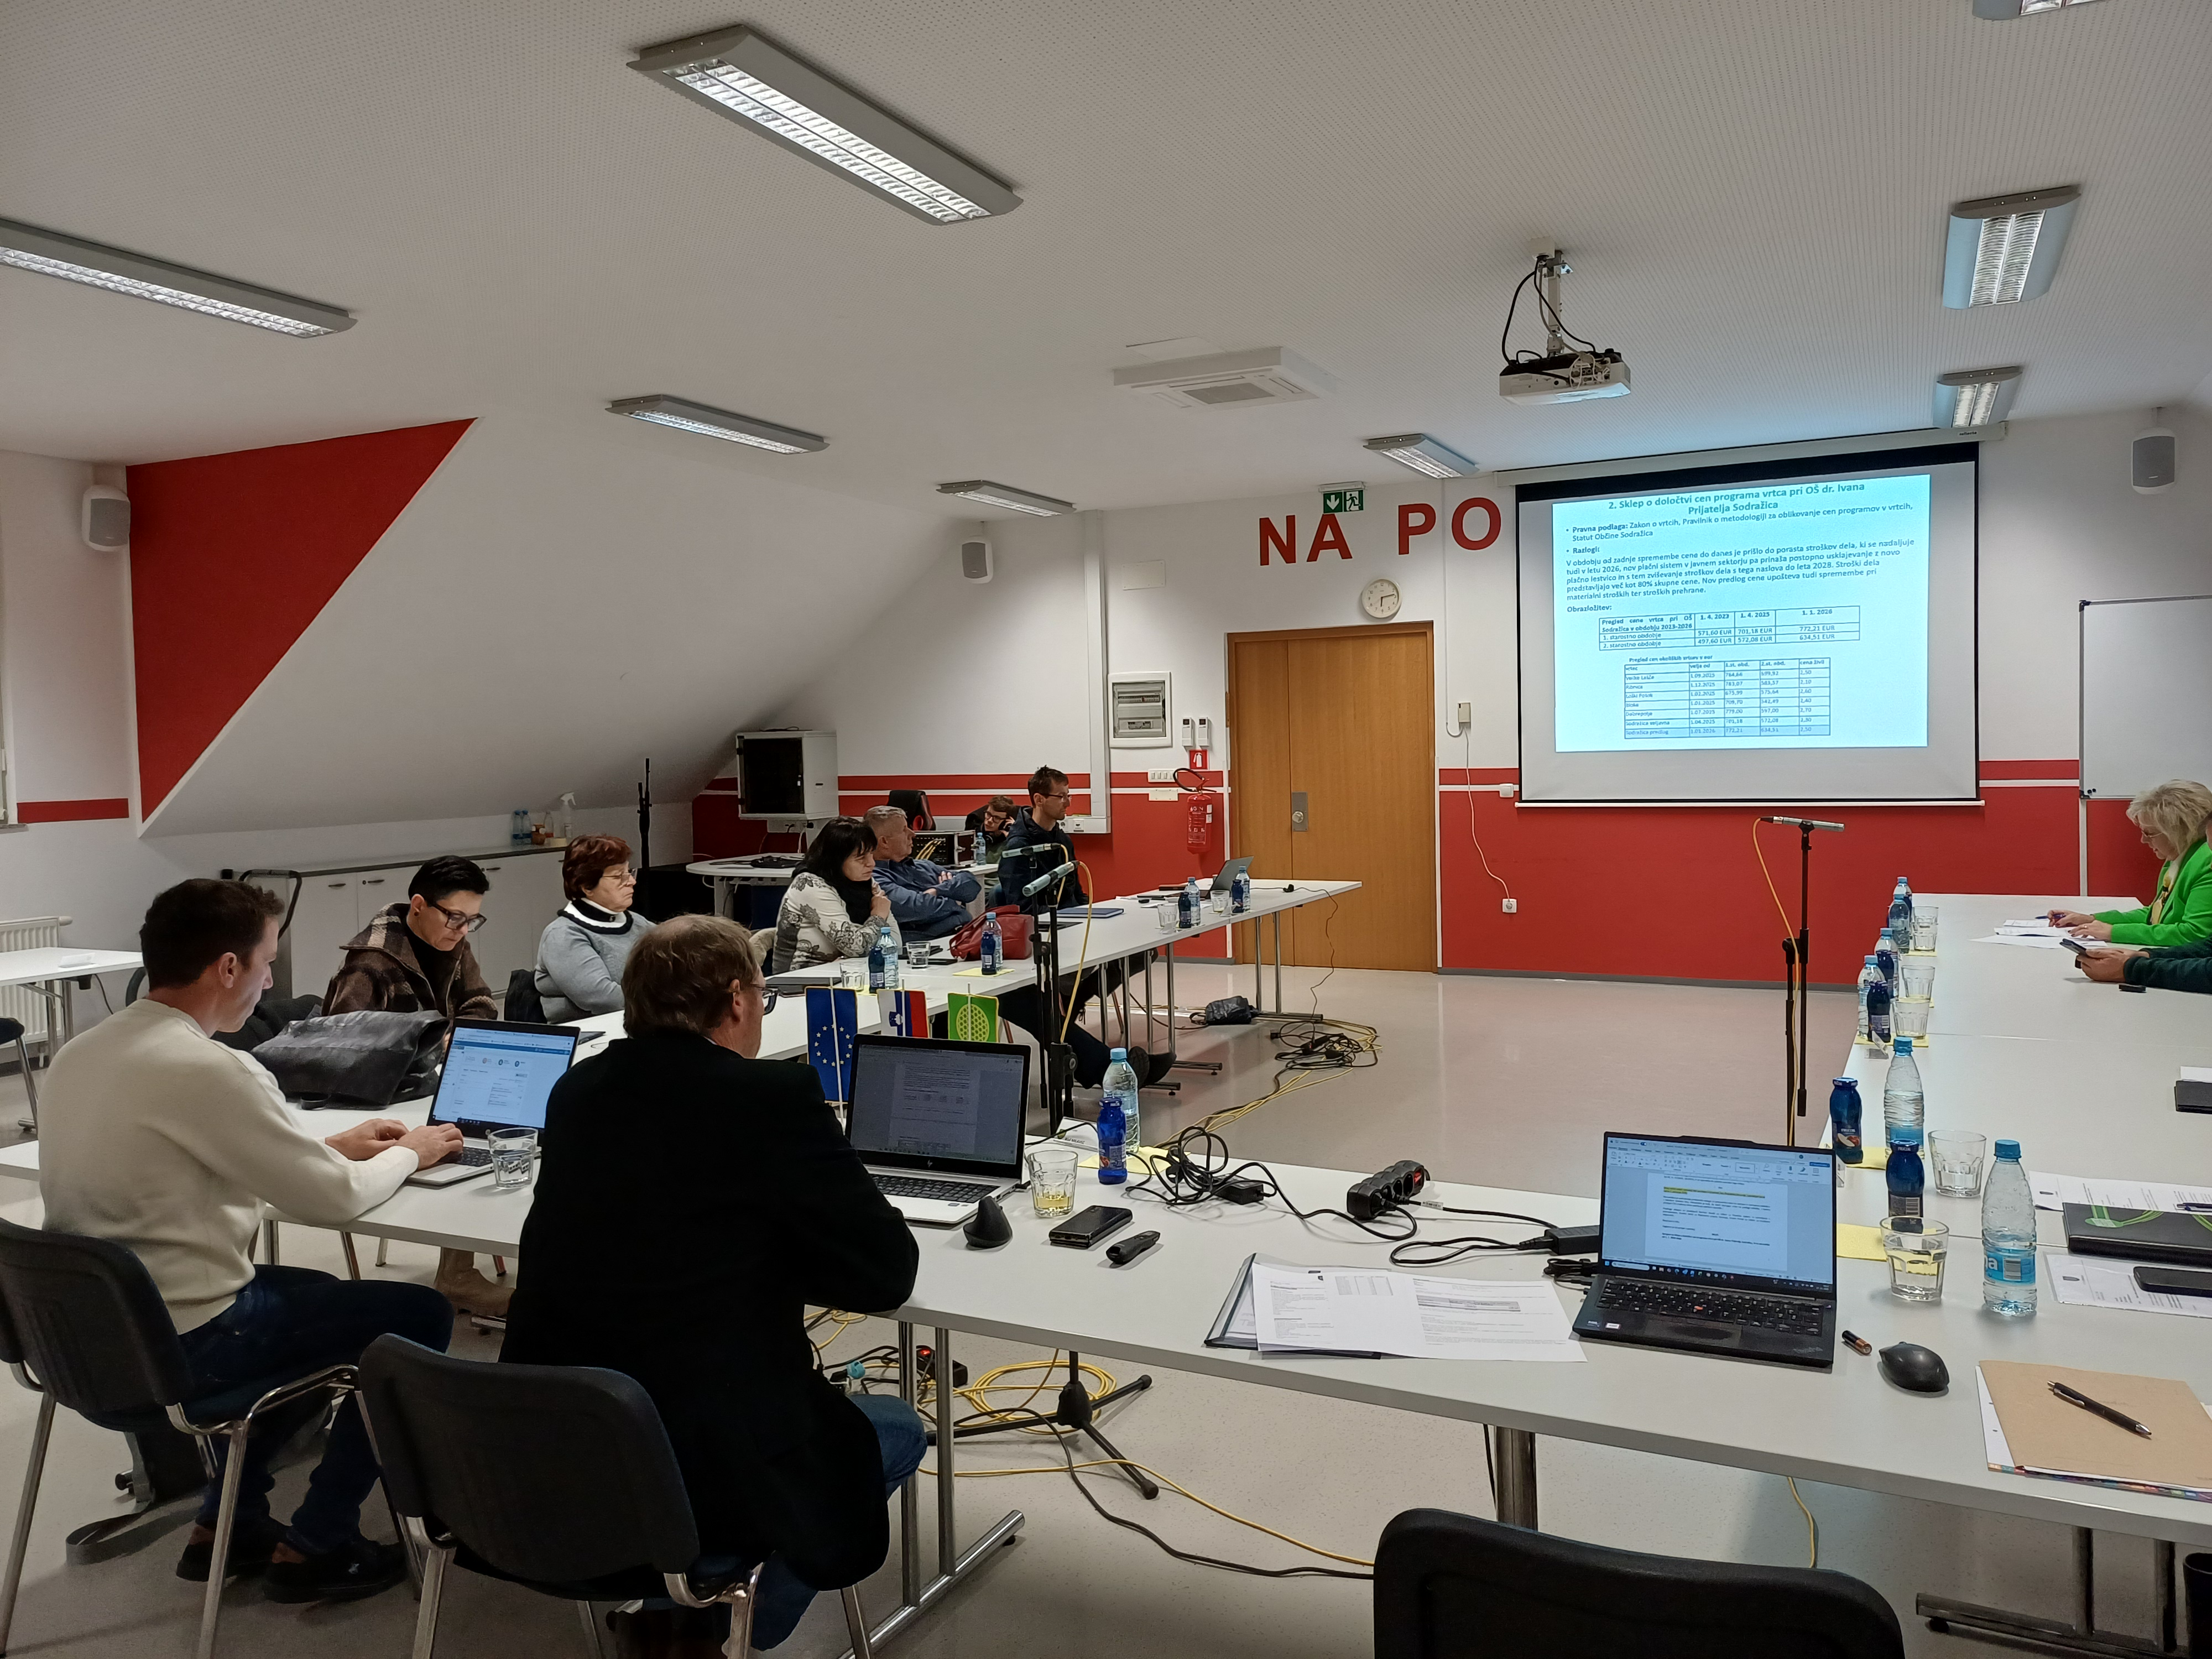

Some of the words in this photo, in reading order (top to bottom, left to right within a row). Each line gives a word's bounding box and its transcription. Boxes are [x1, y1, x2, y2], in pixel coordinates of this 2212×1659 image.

[1619, 499, 1644, 508] Sklep
[1655, 494, 1692, 505] določtvi
[1714, 492, 1759, 503] programa
[1789, 486, 1802, 497] pri
[1806, 484, 1819, 494] OŠ
[1822, 484, 1834, 493] dr.
[1688, 503, 1730, 515] Prijatelja
[1733, 500, 1778, 511] Sodražica
[1598, 523, 1628, 532] podlaga:
[1682, 516, 1712, 524] Pravilnik
[1778, 509, 1820, 518] oblikovanje
[1838, 507, 1880, 515] programov
[1259, 515, 1353, 566] NA
[1399, 497, 1501, 555] PO
[1637, 552, 1679, 563] spremembe
[1743, 547, 1763, 556] prišlo
[1776, 546, 1803, 554] porasta
[1879, 539, 1914, 547] nadaljuje
[1718, 557, 1747, 566] sektorju
[1789, 554, 1824, 562] postopno
[1567, 576, 1589, 585] plačno
[1647, 570, 1682, 578] zviševanje
[1718, 576, 1745, 584] predlog
[1819, 569, 1864, 578] spremembe
[1672, 587, 1705, 595] prehrane.
